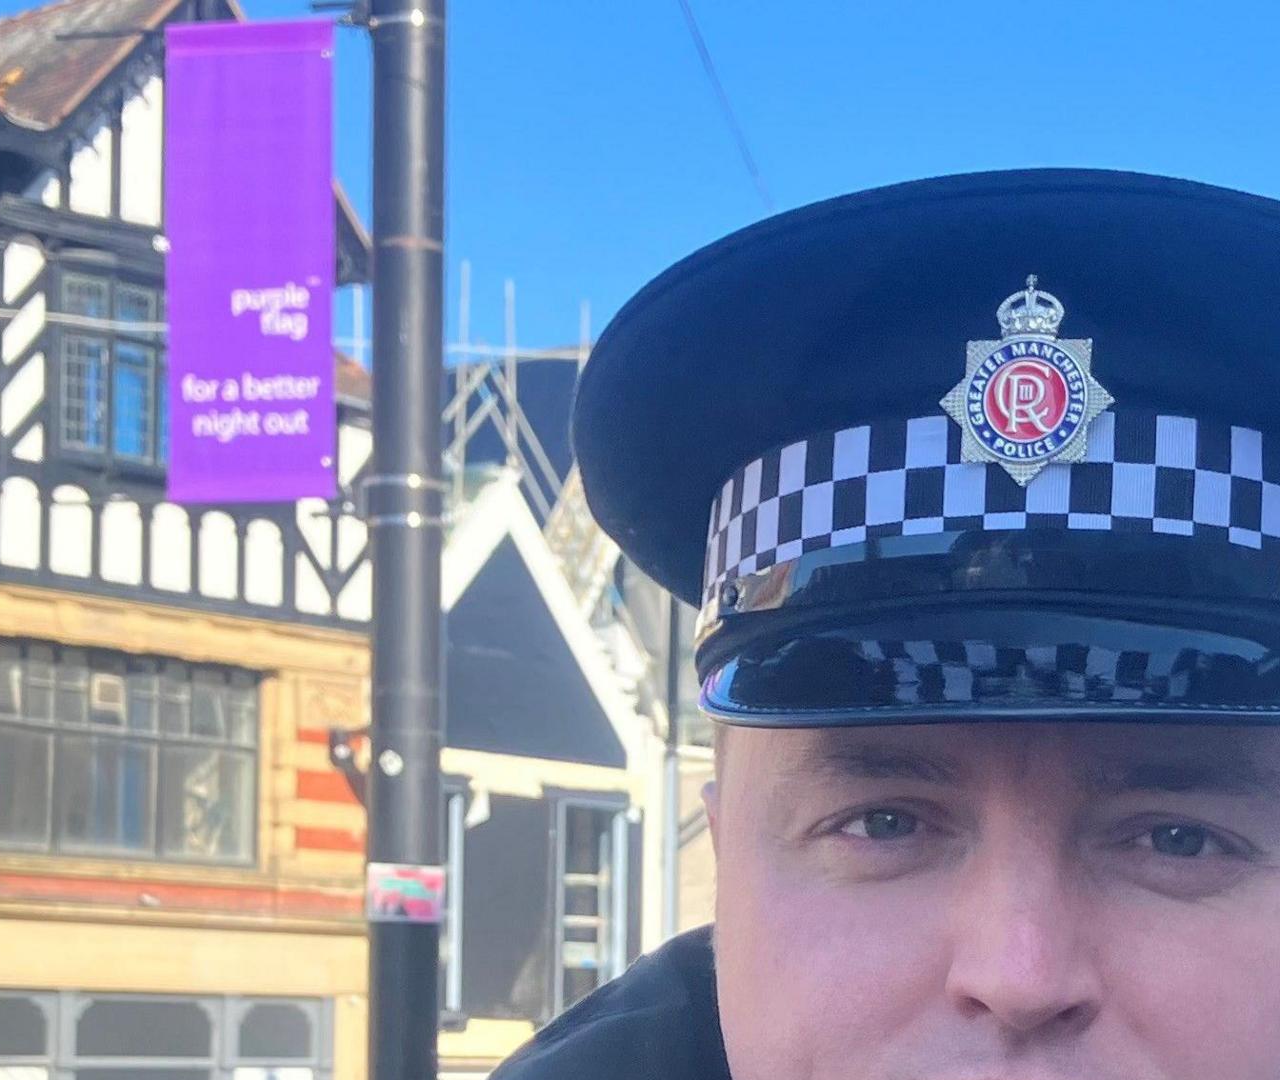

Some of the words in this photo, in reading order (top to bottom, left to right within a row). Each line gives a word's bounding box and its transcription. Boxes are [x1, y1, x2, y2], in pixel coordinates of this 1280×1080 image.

[231, 282, 309, 316] purple
[261, 309, 308, 340] flag
[182, 373, 218, 401] for
[222, 378, 239, 401] a
[242, 372, 320, 401] better
[969, 352, 1007, 426] GREATER
[1011, 342, 1085, 425] MANCHESTER
[192, 407, 260, 442] night
[263, 409, 309, 436] out
[993, 436, 1055, 458] POLICE
